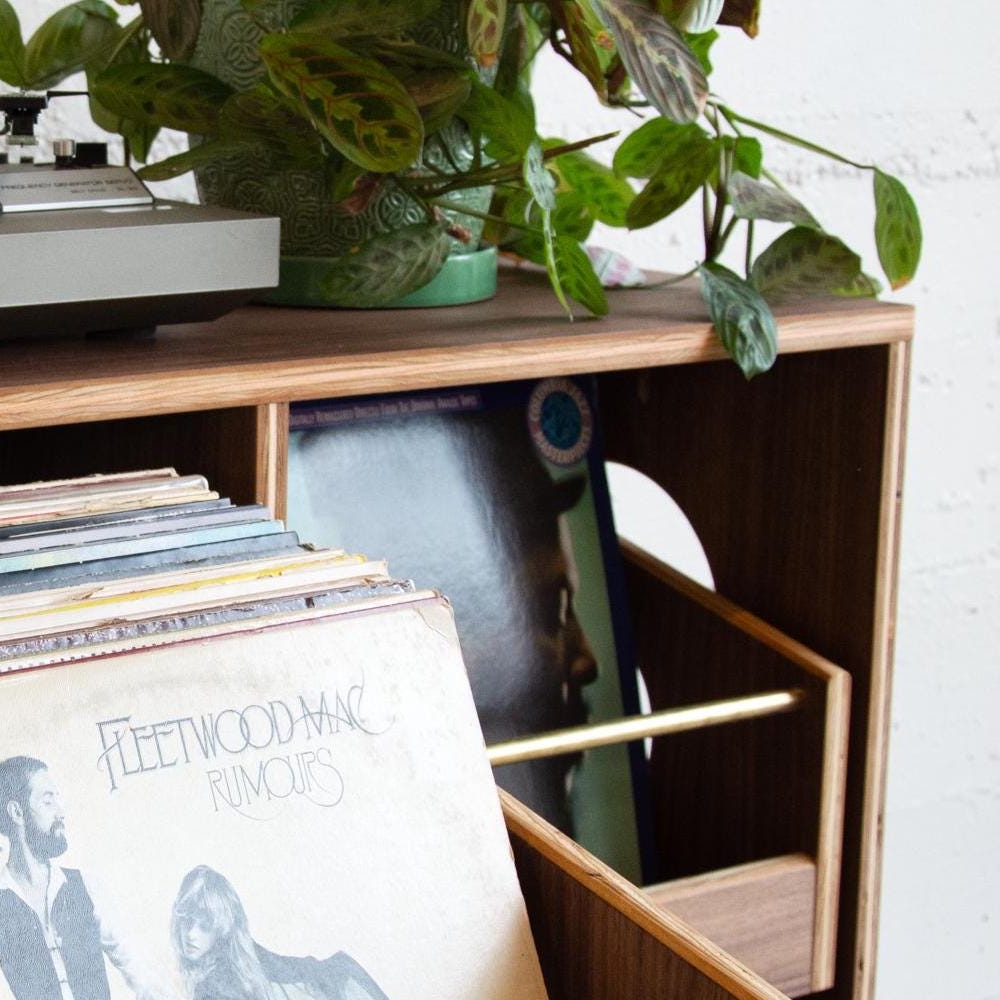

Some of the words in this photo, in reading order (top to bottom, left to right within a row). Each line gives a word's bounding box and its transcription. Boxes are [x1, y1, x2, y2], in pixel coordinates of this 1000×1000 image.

[96, 700, 295, 792] FLEETWOOD
[296, 666, 396, 740] MAC
[207, 748, 344, 821] RUMOURS
